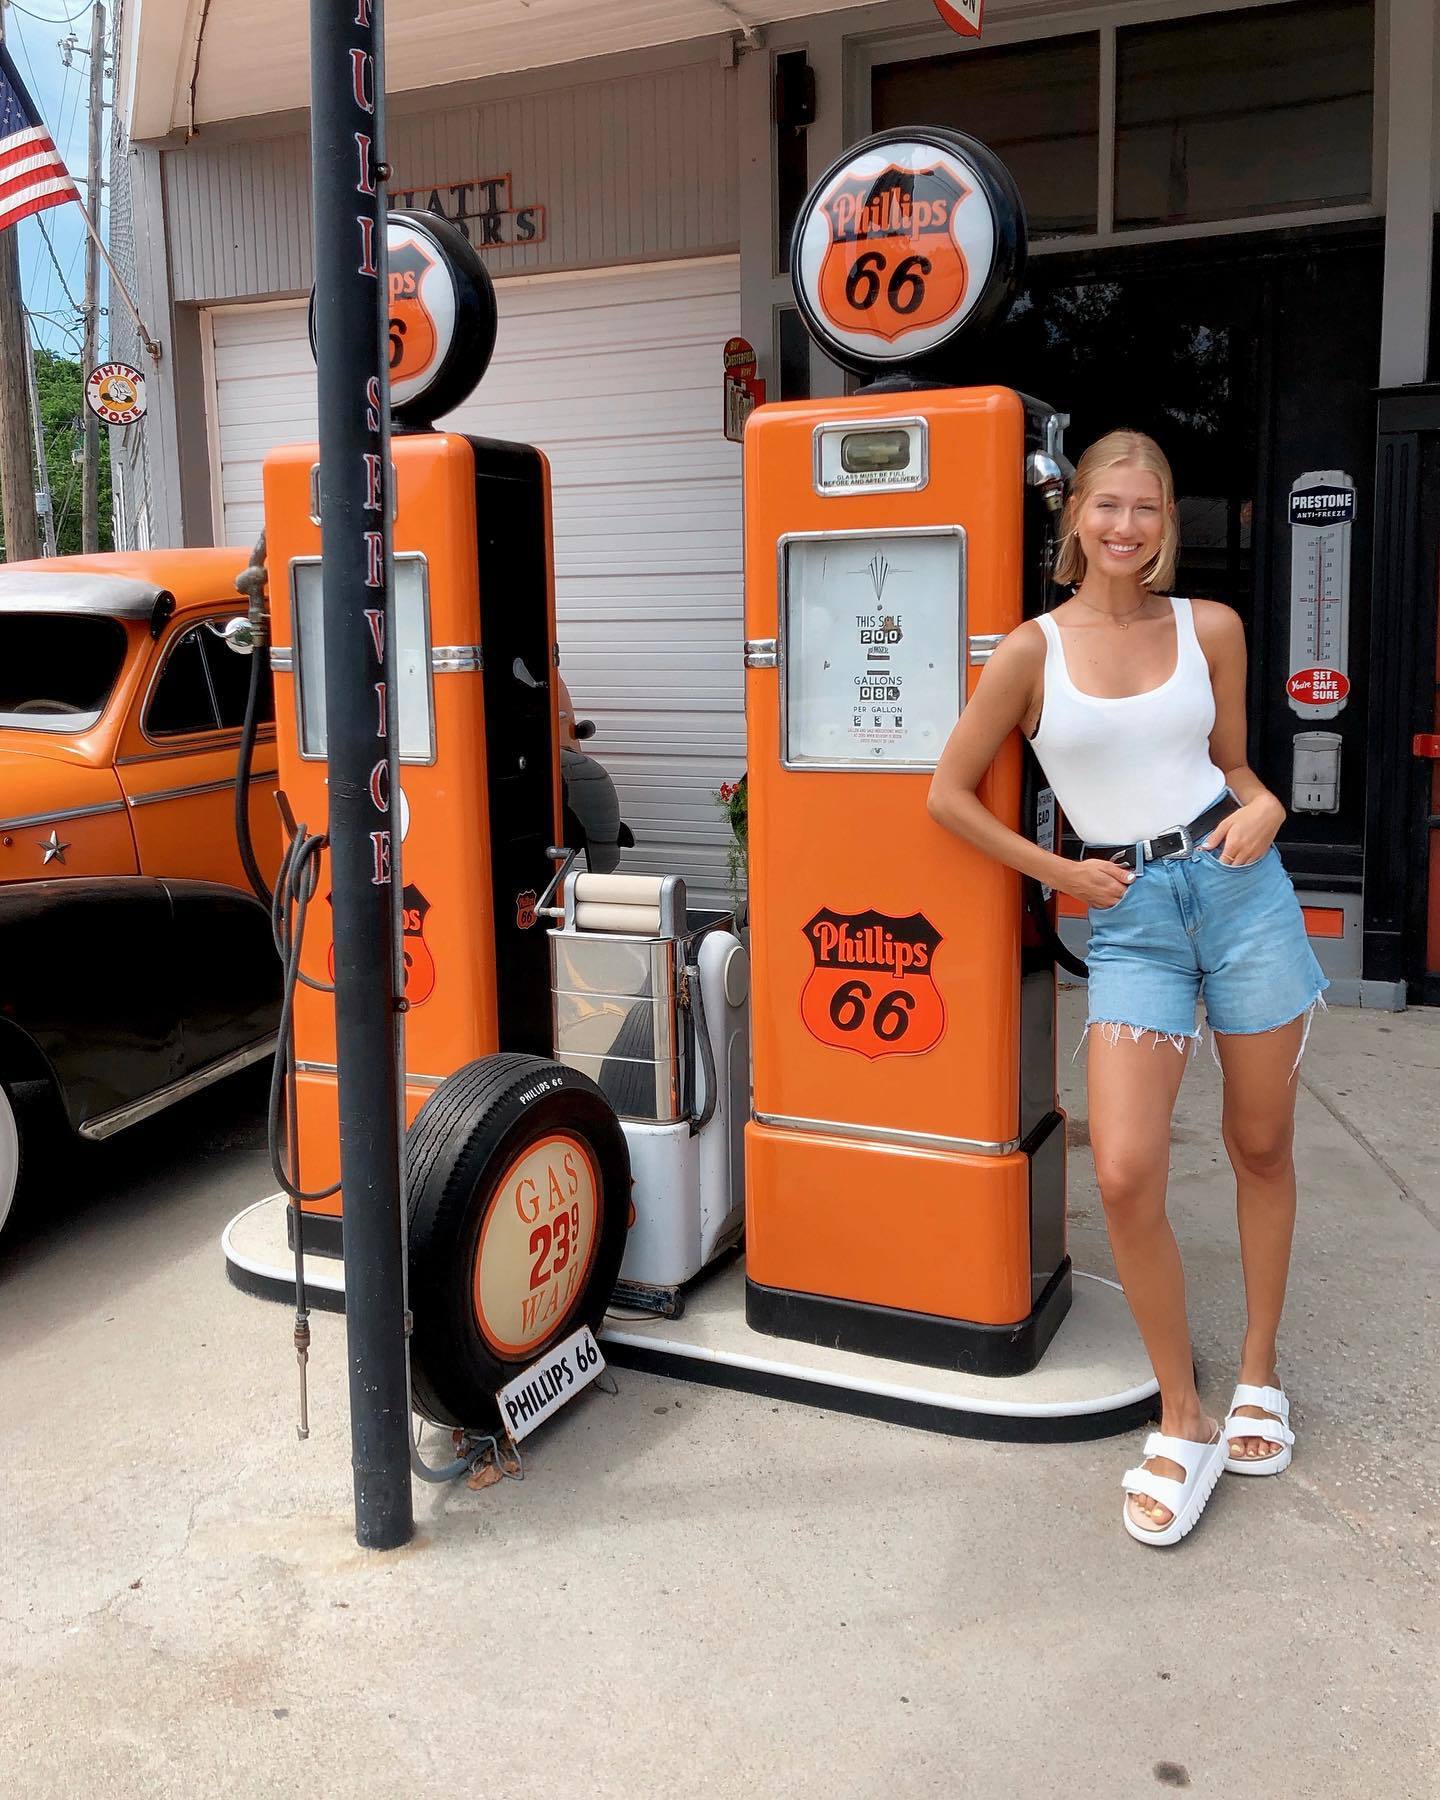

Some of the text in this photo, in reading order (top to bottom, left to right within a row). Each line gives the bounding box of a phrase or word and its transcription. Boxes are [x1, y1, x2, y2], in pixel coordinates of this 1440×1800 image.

[832, 186, 947, 241] Phillips
[845, 251, 933, 315] 66
[90, 365, 142, 386] WHITE
[97, 405, 142, 422] ROSE
[823, 479, 849, 487] BEFORE
[887, 475, 920, 483] DELIVERY
[1292, 493, 1352, 510] PRESTONE
[1296, 509, 1347, 519] ANTI-FREEZE
[362, 375, 391, 885] SERVICE
[855, 615, 902, 628] THIS SLE
[854, 676, 903, 686] GALLONS
[1312, 671, 1332, 680] SET
[1312, 681, 1338, 690] SAFE
[1312, 691, 1340, 700] SURE
[812, 920, 929, 979] Phillips
[829, 979, 916, 1042] 66
[519, 1077, 563, 1105] PHILLIPS 66
[515, 1151, 579, 1224] GAS
[521, 1261, 579, 1335] WAR
[504, 1338, 598, 1430] PHILLIPS 66
